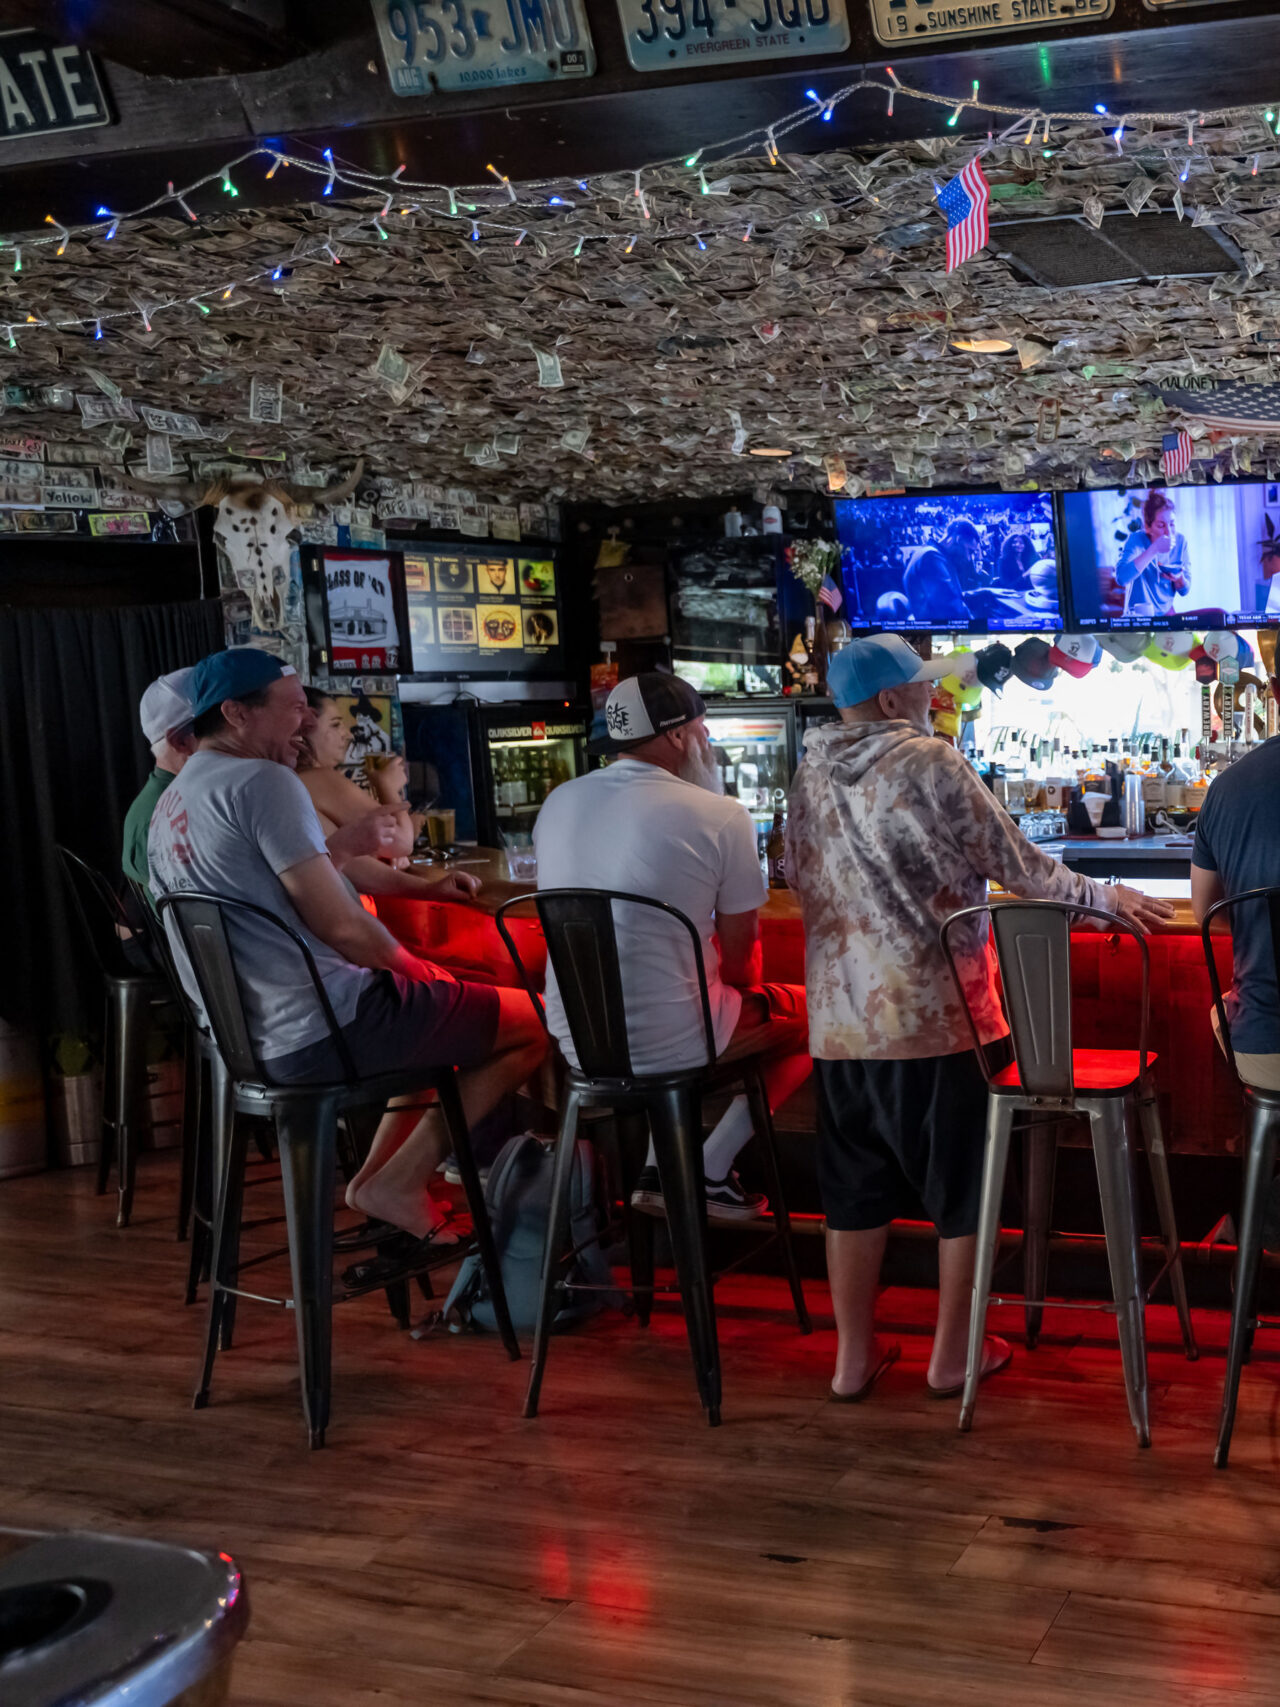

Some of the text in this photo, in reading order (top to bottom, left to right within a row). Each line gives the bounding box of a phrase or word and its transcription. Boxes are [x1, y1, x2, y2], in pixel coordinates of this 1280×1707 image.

[926, 8, 1001, 29] SUNSHINE
[1011, 0, 1057, 17] STATE
[390, 0, 476, 66] 953
[686, 33, 791, 55] EVERGREEN STATE
[398, 68, 419, 88] AUG
[459, 66, 528, 83] 10,000 lakes
[0, 45, 98, 128] ATE
[353, 570, 366, 589] OF
[488, 726, 533, 739] QUIKSILVER
